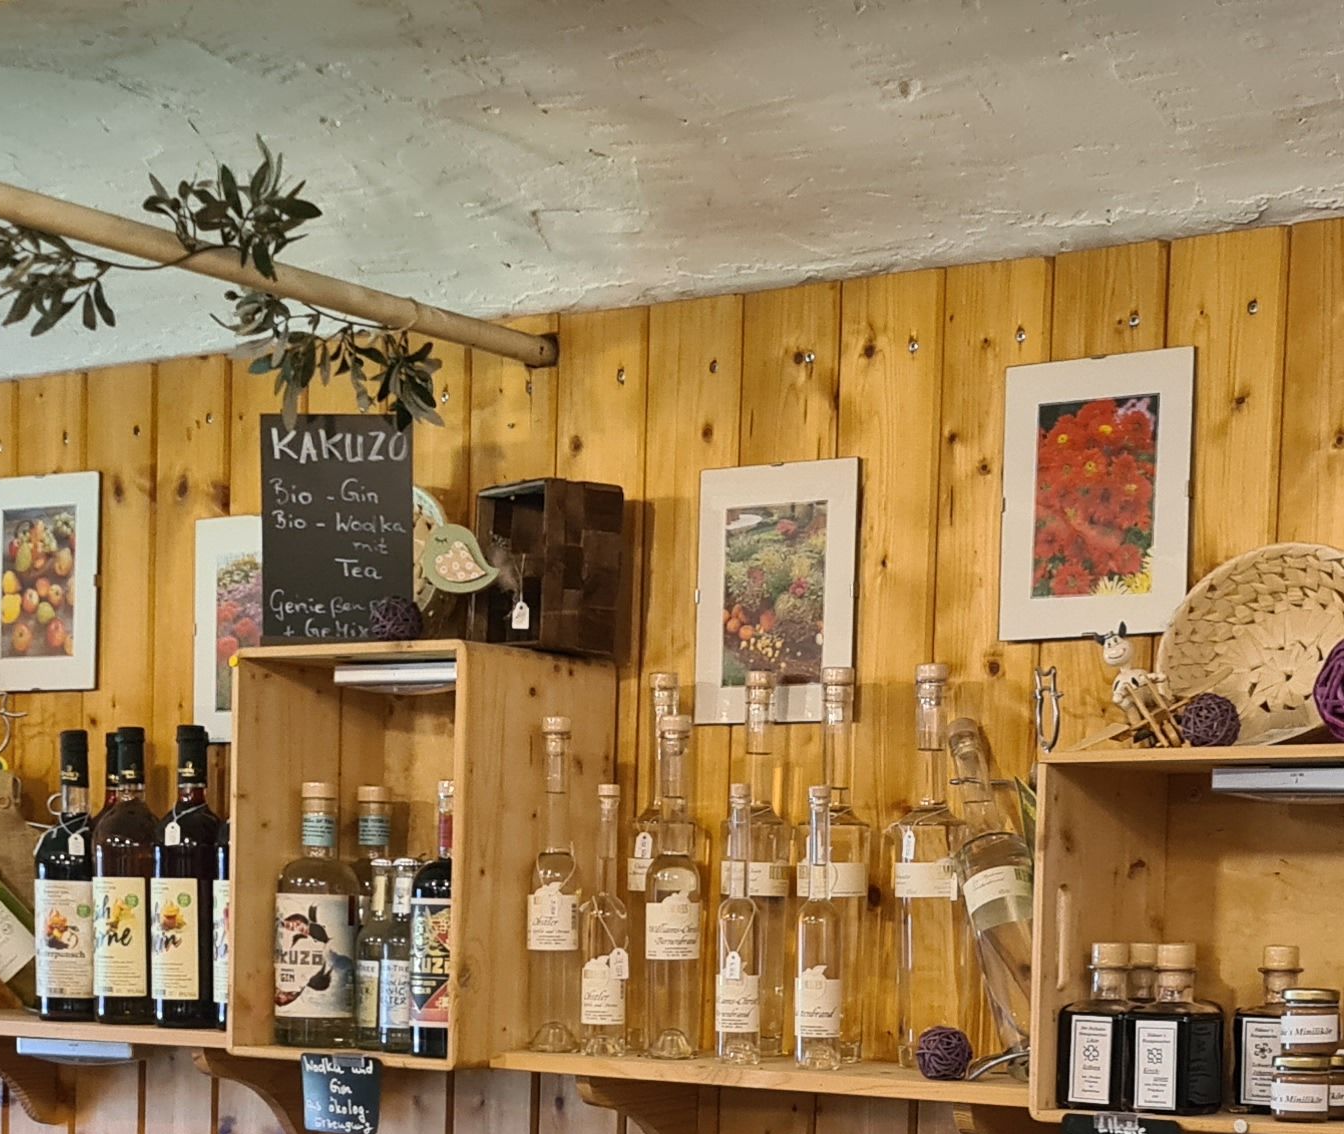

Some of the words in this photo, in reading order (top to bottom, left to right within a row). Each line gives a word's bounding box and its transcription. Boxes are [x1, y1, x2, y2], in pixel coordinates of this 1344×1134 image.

[271, 427, 409, 464] KAKUZO
[269, 477, 313, 505] Bio
[341, 478, 379, 504] Gin
[272, 510, 307, 529] Bio
[336, 512, 406, 533] Wodka
[352, 537, 389, 555] mit
[334, 558, 383, 580] Tea
[1295, 1027, 1333, 1036] Minilikör
[329, 1078, 353, 1095] Gin
